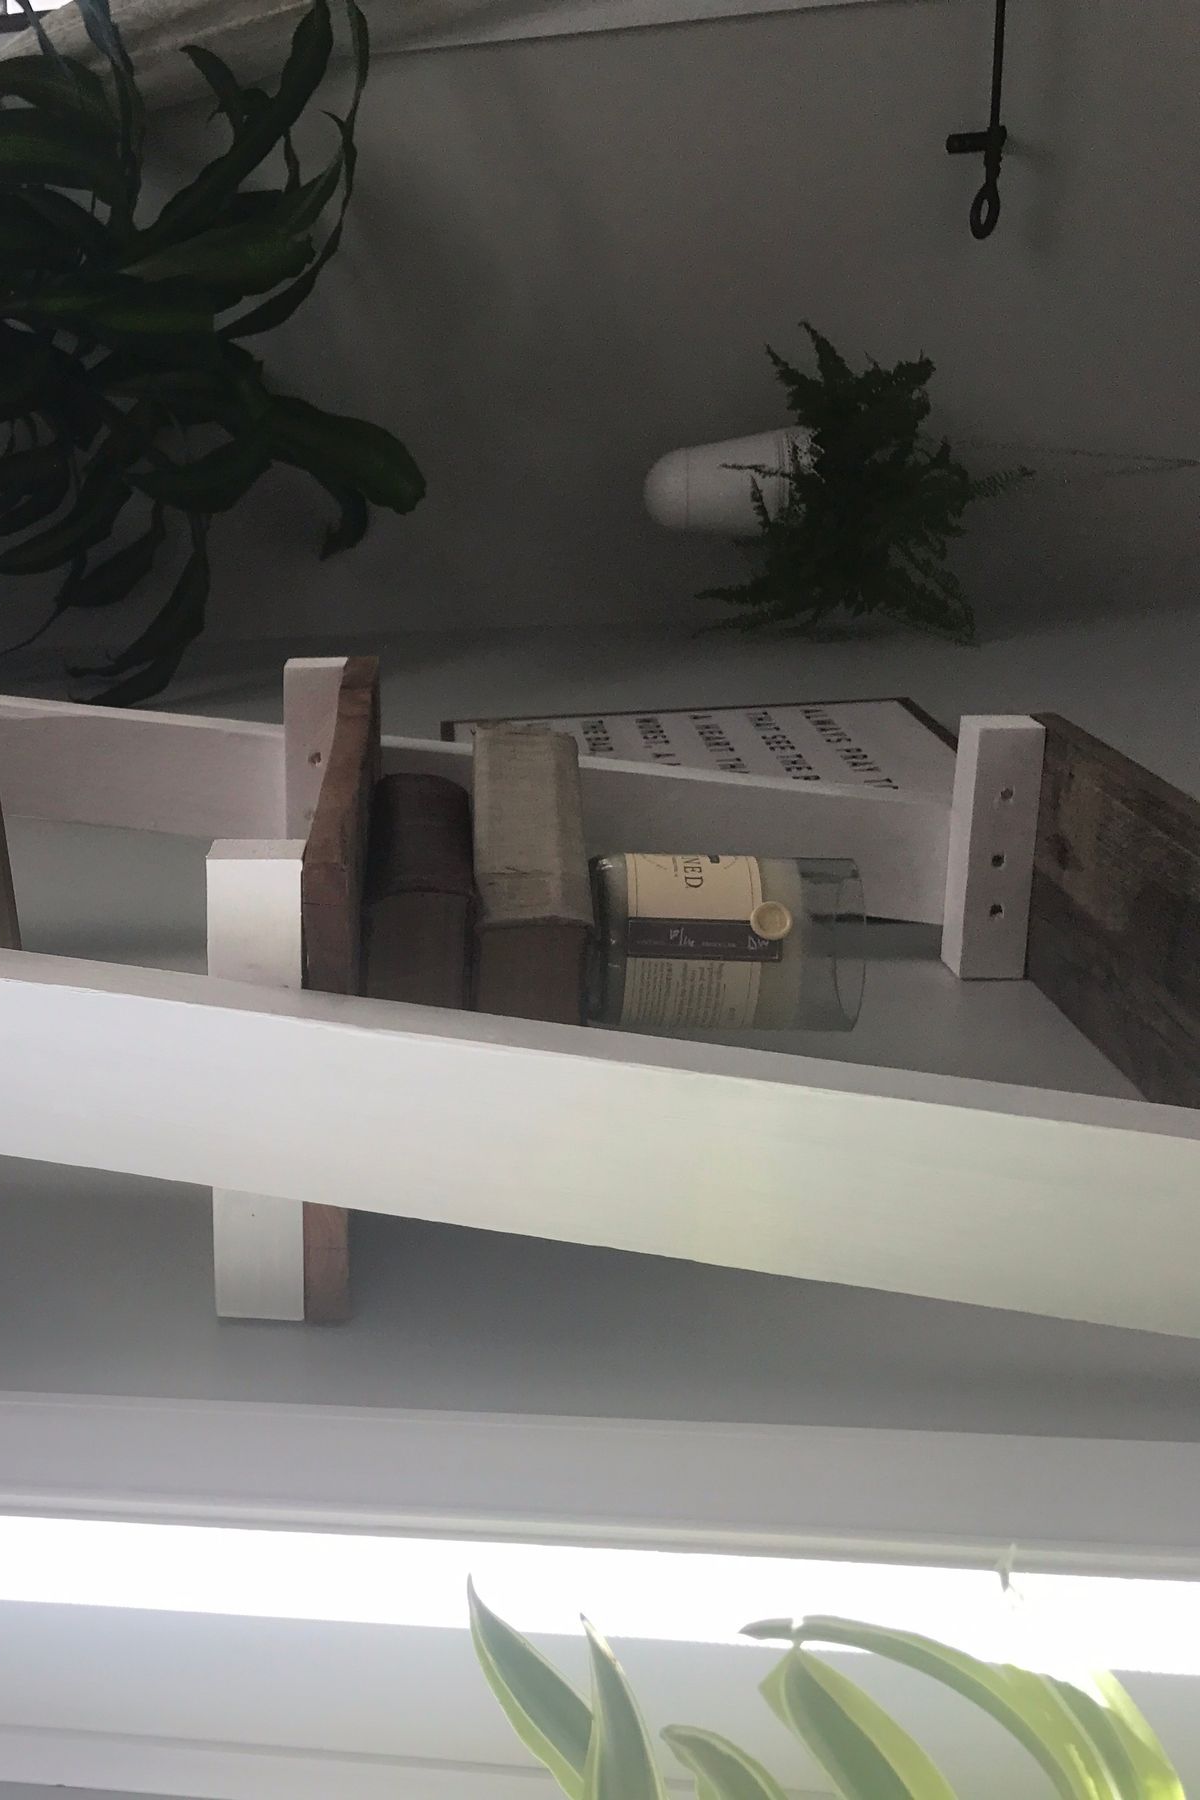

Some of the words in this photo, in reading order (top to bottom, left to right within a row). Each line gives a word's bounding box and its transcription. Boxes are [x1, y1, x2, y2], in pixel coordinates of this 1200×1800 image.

[581, 719, 608, 734] THE
[747, 711, 781, 732] THAT
[695, 723, 735, 752] HEART
[761, 734, 796, 751] SEE
[802, 709, 852, 743] ALWAYS
[835, 748, 881, 772] PRAY
[776, 753, 813, 772] THE
